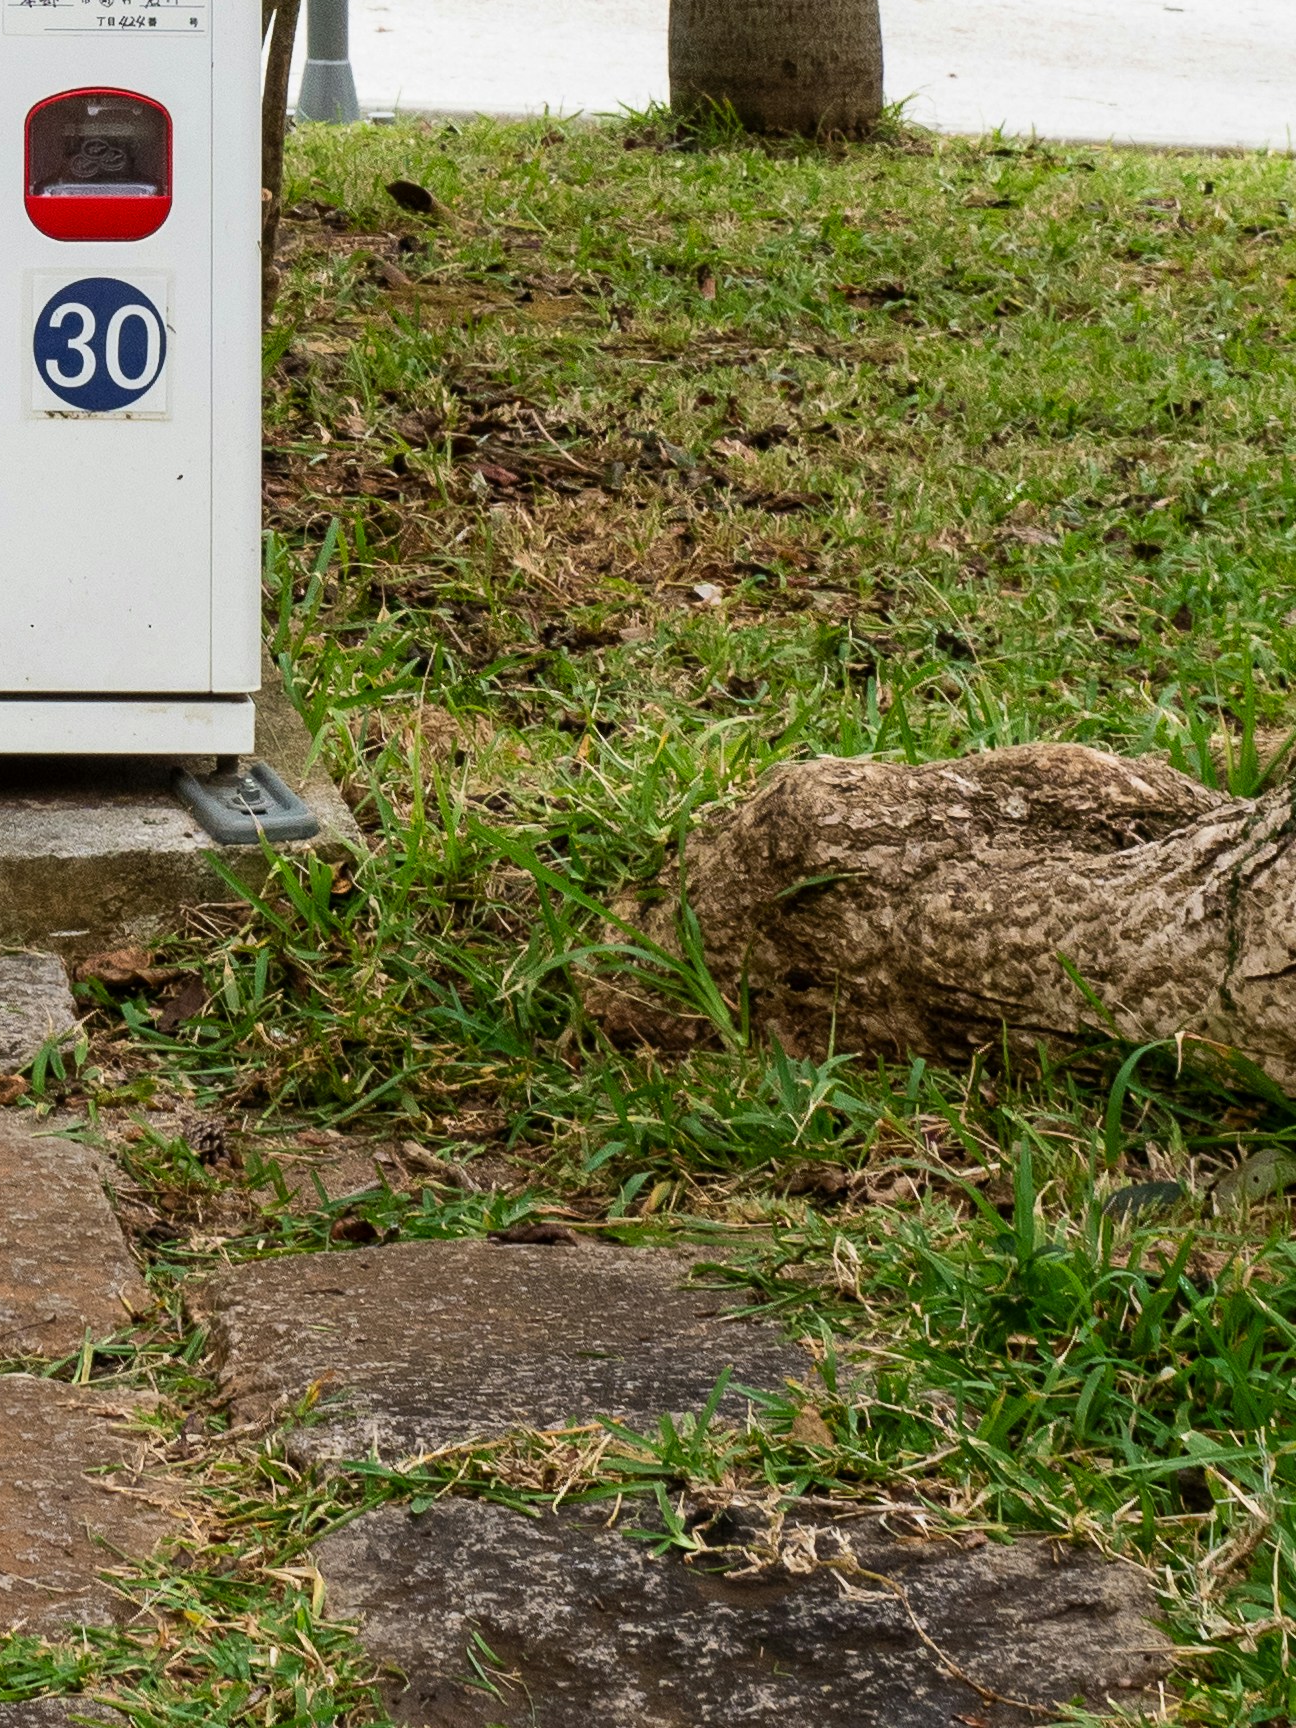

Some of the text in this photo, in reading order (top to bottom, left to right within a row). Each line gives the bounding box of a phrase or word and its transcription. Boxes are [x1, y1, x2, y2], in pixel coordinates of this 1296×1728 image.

[97, 15, 198, 28] 丁目 424 番 号
[45, 302, 161, 390] 30
